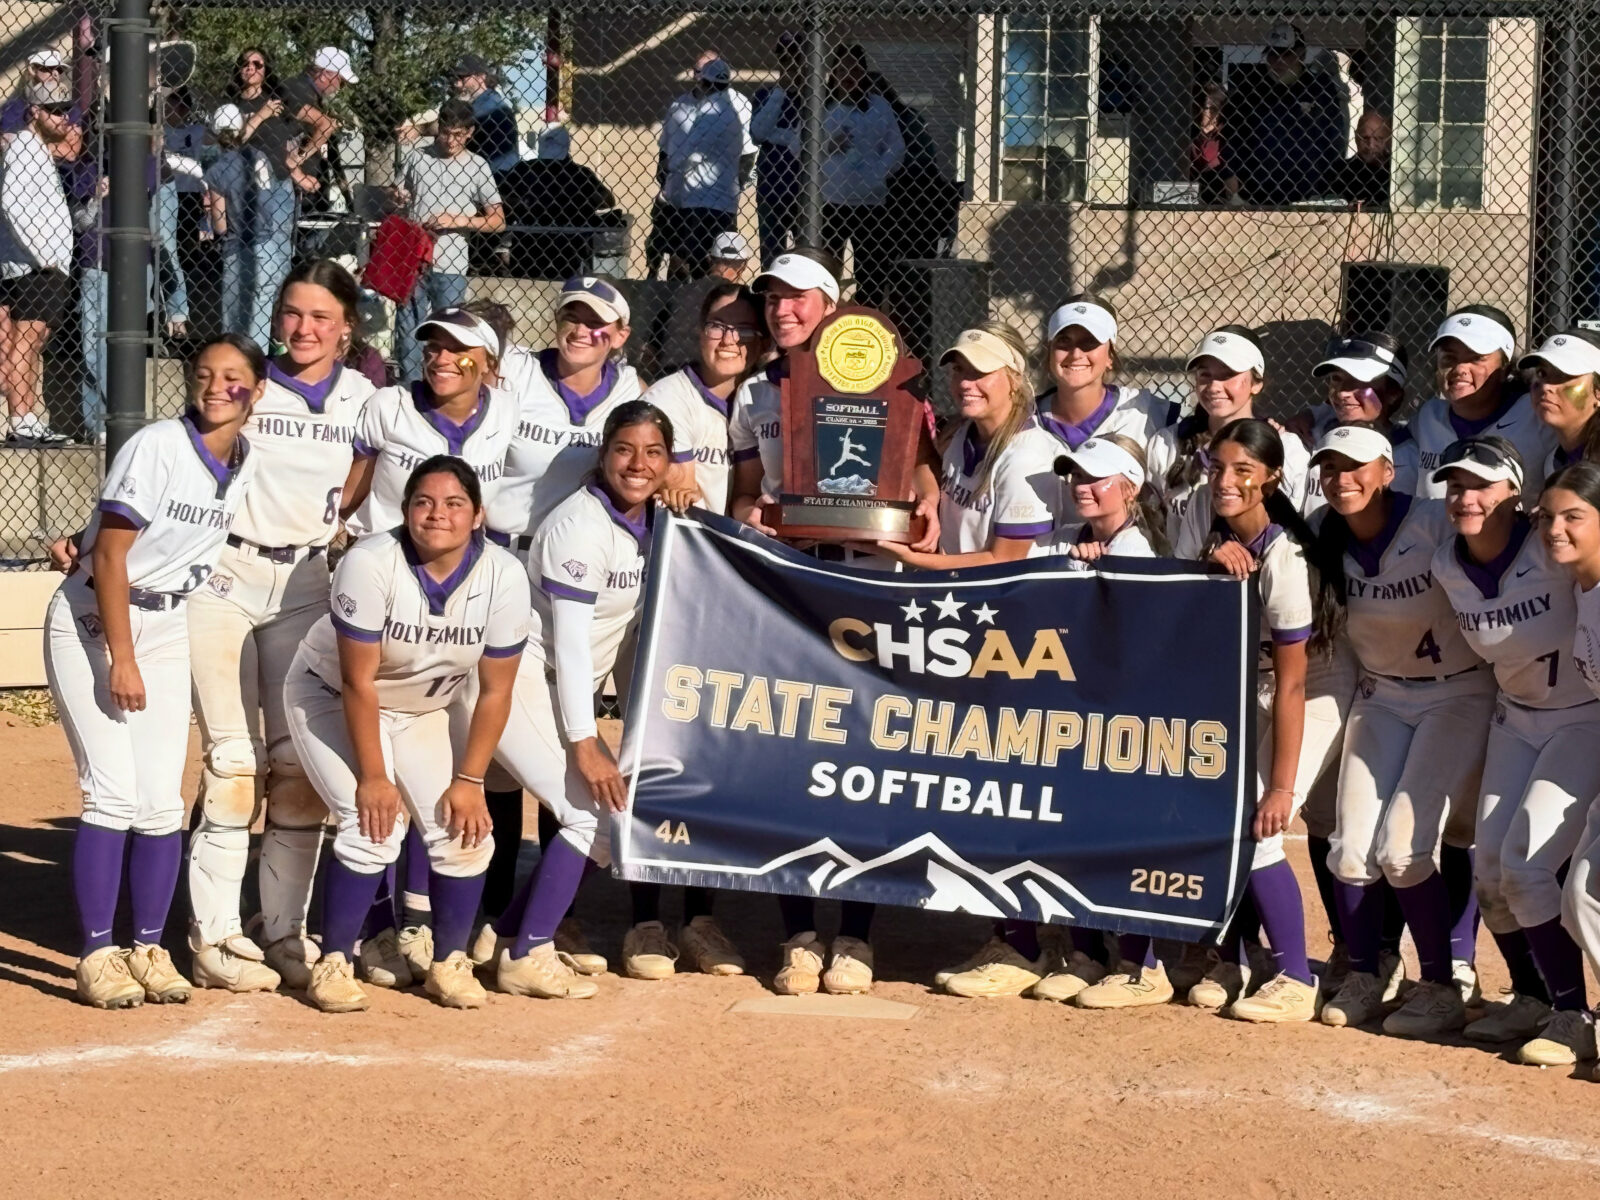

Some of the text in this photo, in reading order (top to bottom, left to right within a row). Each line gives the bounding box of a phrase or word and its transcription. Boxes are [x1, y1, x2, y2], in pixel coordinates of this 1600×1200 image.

[825, 403, 880, 415] SOFTBALL
[257, 417, 306, 438] HOLY
[517, 419, 565, 446] HOLY
[166, 498, 210, 526] HOLY
[803, 496, 888, 510] STATE CHAMPION
[1008, 504, 1035, 519] 1922
[606, 570, 640, 590] HOLY
[1372, 569, 1434, 601] FAMILY
[1484, 592, 1552, 631] FAMILY
[425, 624, 486, 646] FAMILY
[1415, 628, 1443, 665] 4
[828, 617, 1077, 682] CHSAA
[661, 663, 1228, 780] STATE CHAMPIONS
[807, 760, 1063, 822] SOFTBALL
[655, 818, 691, 846] 4A
[1130, 868, 1205, 901] 2025
